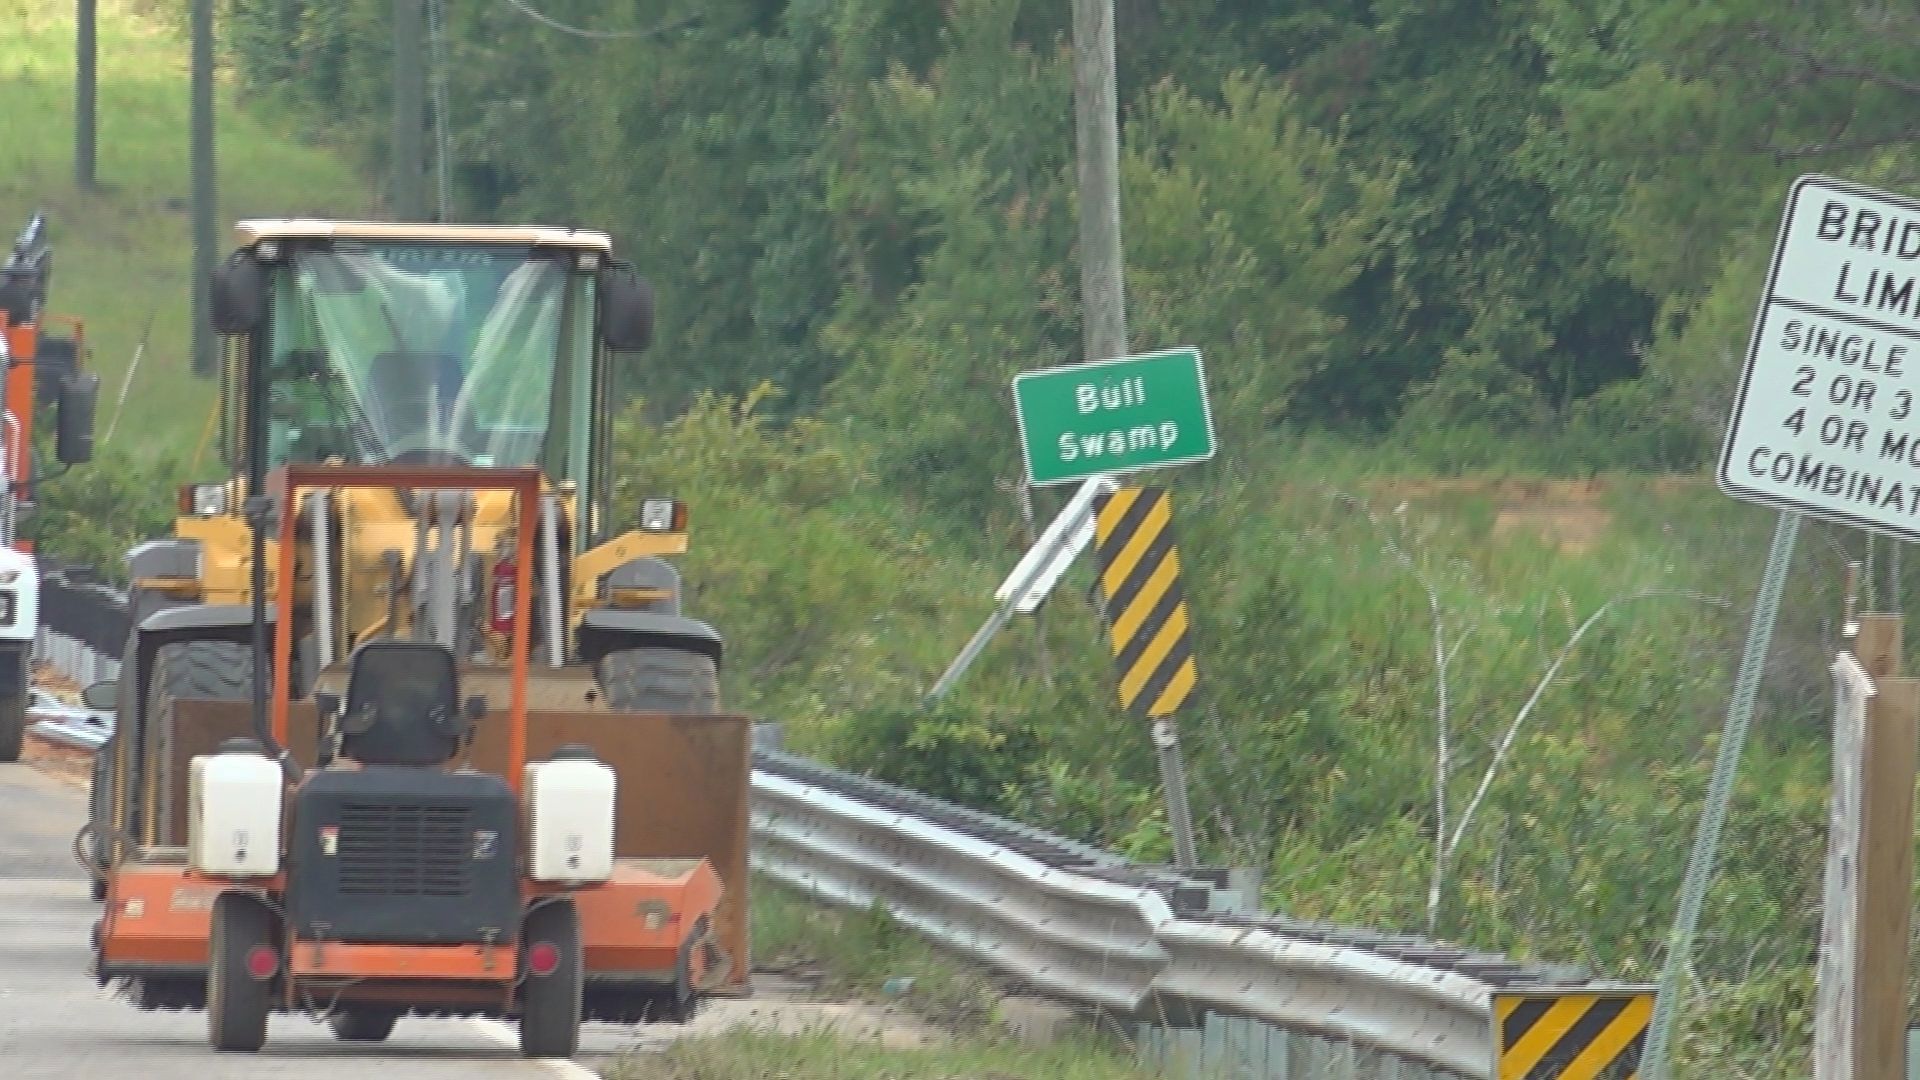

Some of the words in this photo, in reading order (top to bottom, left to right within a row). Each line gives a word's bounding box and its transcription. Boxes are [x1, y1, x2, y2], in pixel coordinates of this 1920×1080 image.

[1816, 200, 1920, 260] BRID
[1780, 320, 1908, 377] SINGLE
[1075, 376, 1146, 414] Bull
[1791, 365, 1816, 397] 2
[1828, 375, 1878, 413] OR
[1888, 389, 1914, 420] 3
[1058, 420, 1179, 461] Swamp
[1781, 407, 1807, 437] 4
[1820, 415, 1869, 453] OR
